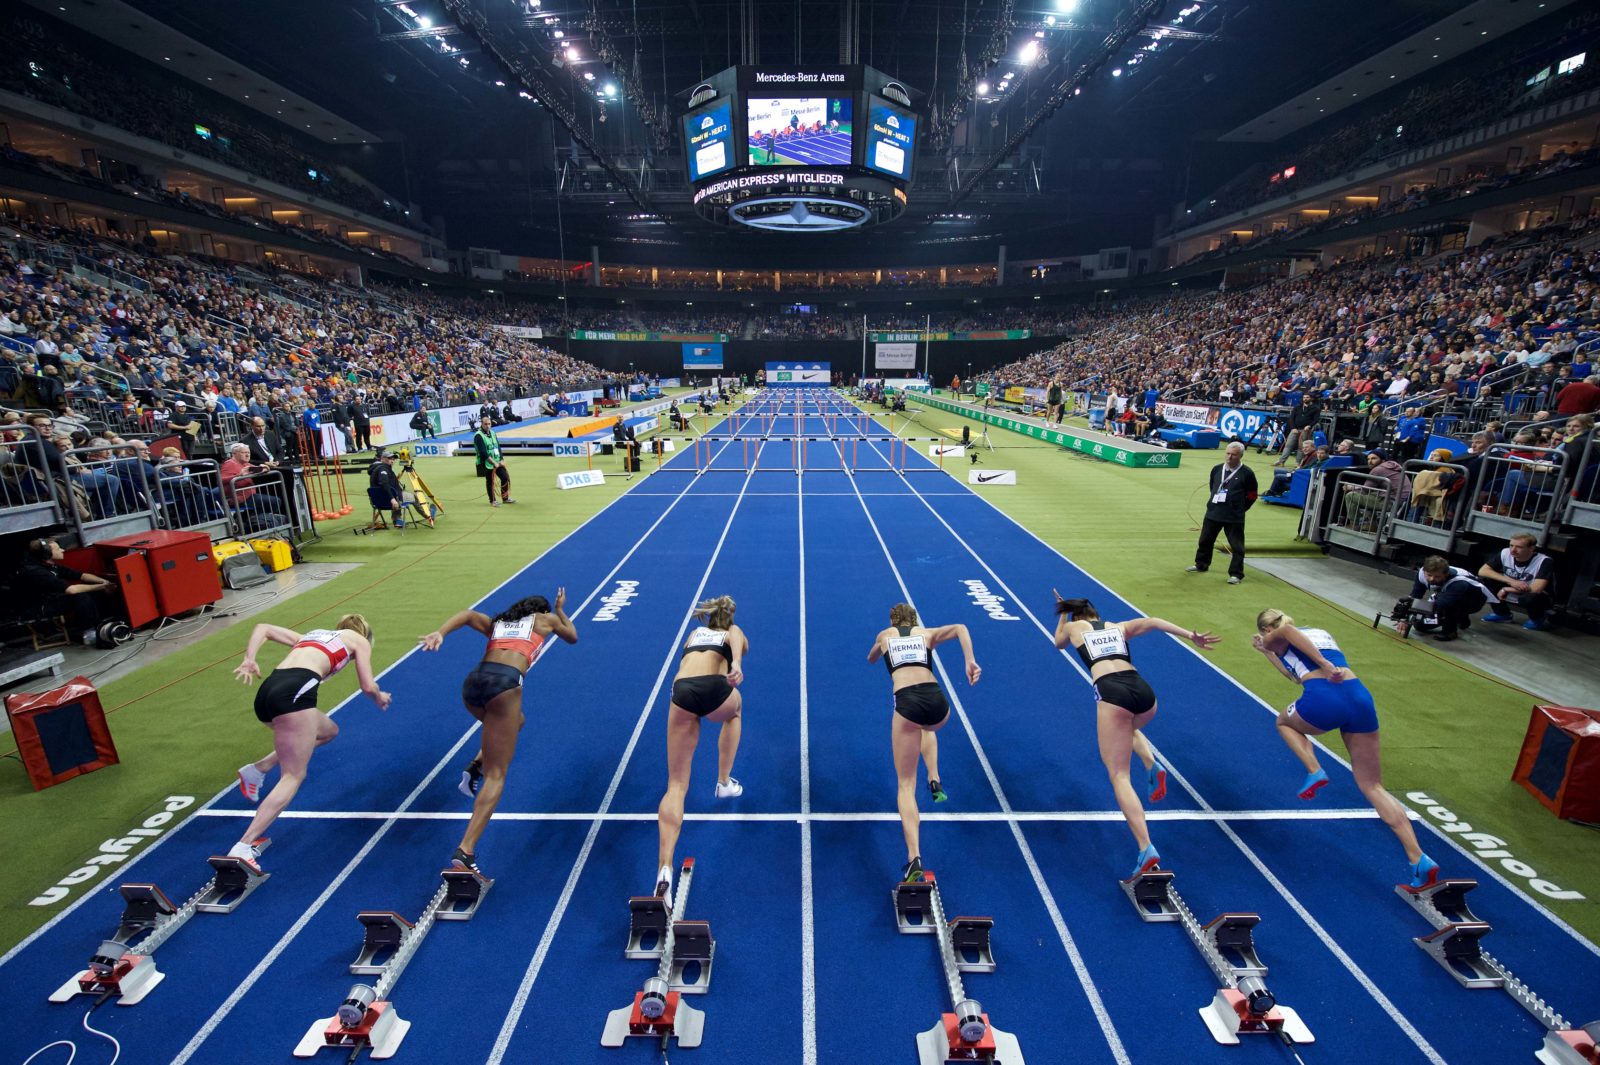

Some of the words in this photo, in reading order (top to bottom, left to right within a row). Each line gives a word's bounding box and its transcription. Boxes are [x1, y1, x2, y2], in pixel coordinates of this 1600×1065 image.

[756, 72, 819, 83] Mercedes-Benz
[820, 72, 845, 82] Arena
[705, 178, 738, 196] AMERICAN
[786, 173, 844, 185] MITGLIEDER
[584, 331, 598, 340] FÜR
[598, 331, 616, 341] MEHR
[887, 332, 894, 341] IN
[895, 331, 918, 341] BERLIN
[1165, 406, 1173, 416] Für
[1173, 407, 1186, 418] Berlin
[1185, 410, 1193, 419] am
[1192, 410, 1207, 421] Start!
[415, 444, 438, 455] DKB
[556, 445, 580, 455] DKB
[1093, 444, 1103, 454] AOK
[1116, 450, 1127, 461] AOK
[1147, 454, 1169, 464] AOK
[564, 473, 592, 486] DKB
[591, 580, 640, 621] polytan
[963, 579, 1021, 620] polytan
[892, 644, 923, 653] HERMAN
[27, 795, 196, 906] polytan
[1405, 791, 1587, 900] polytan
